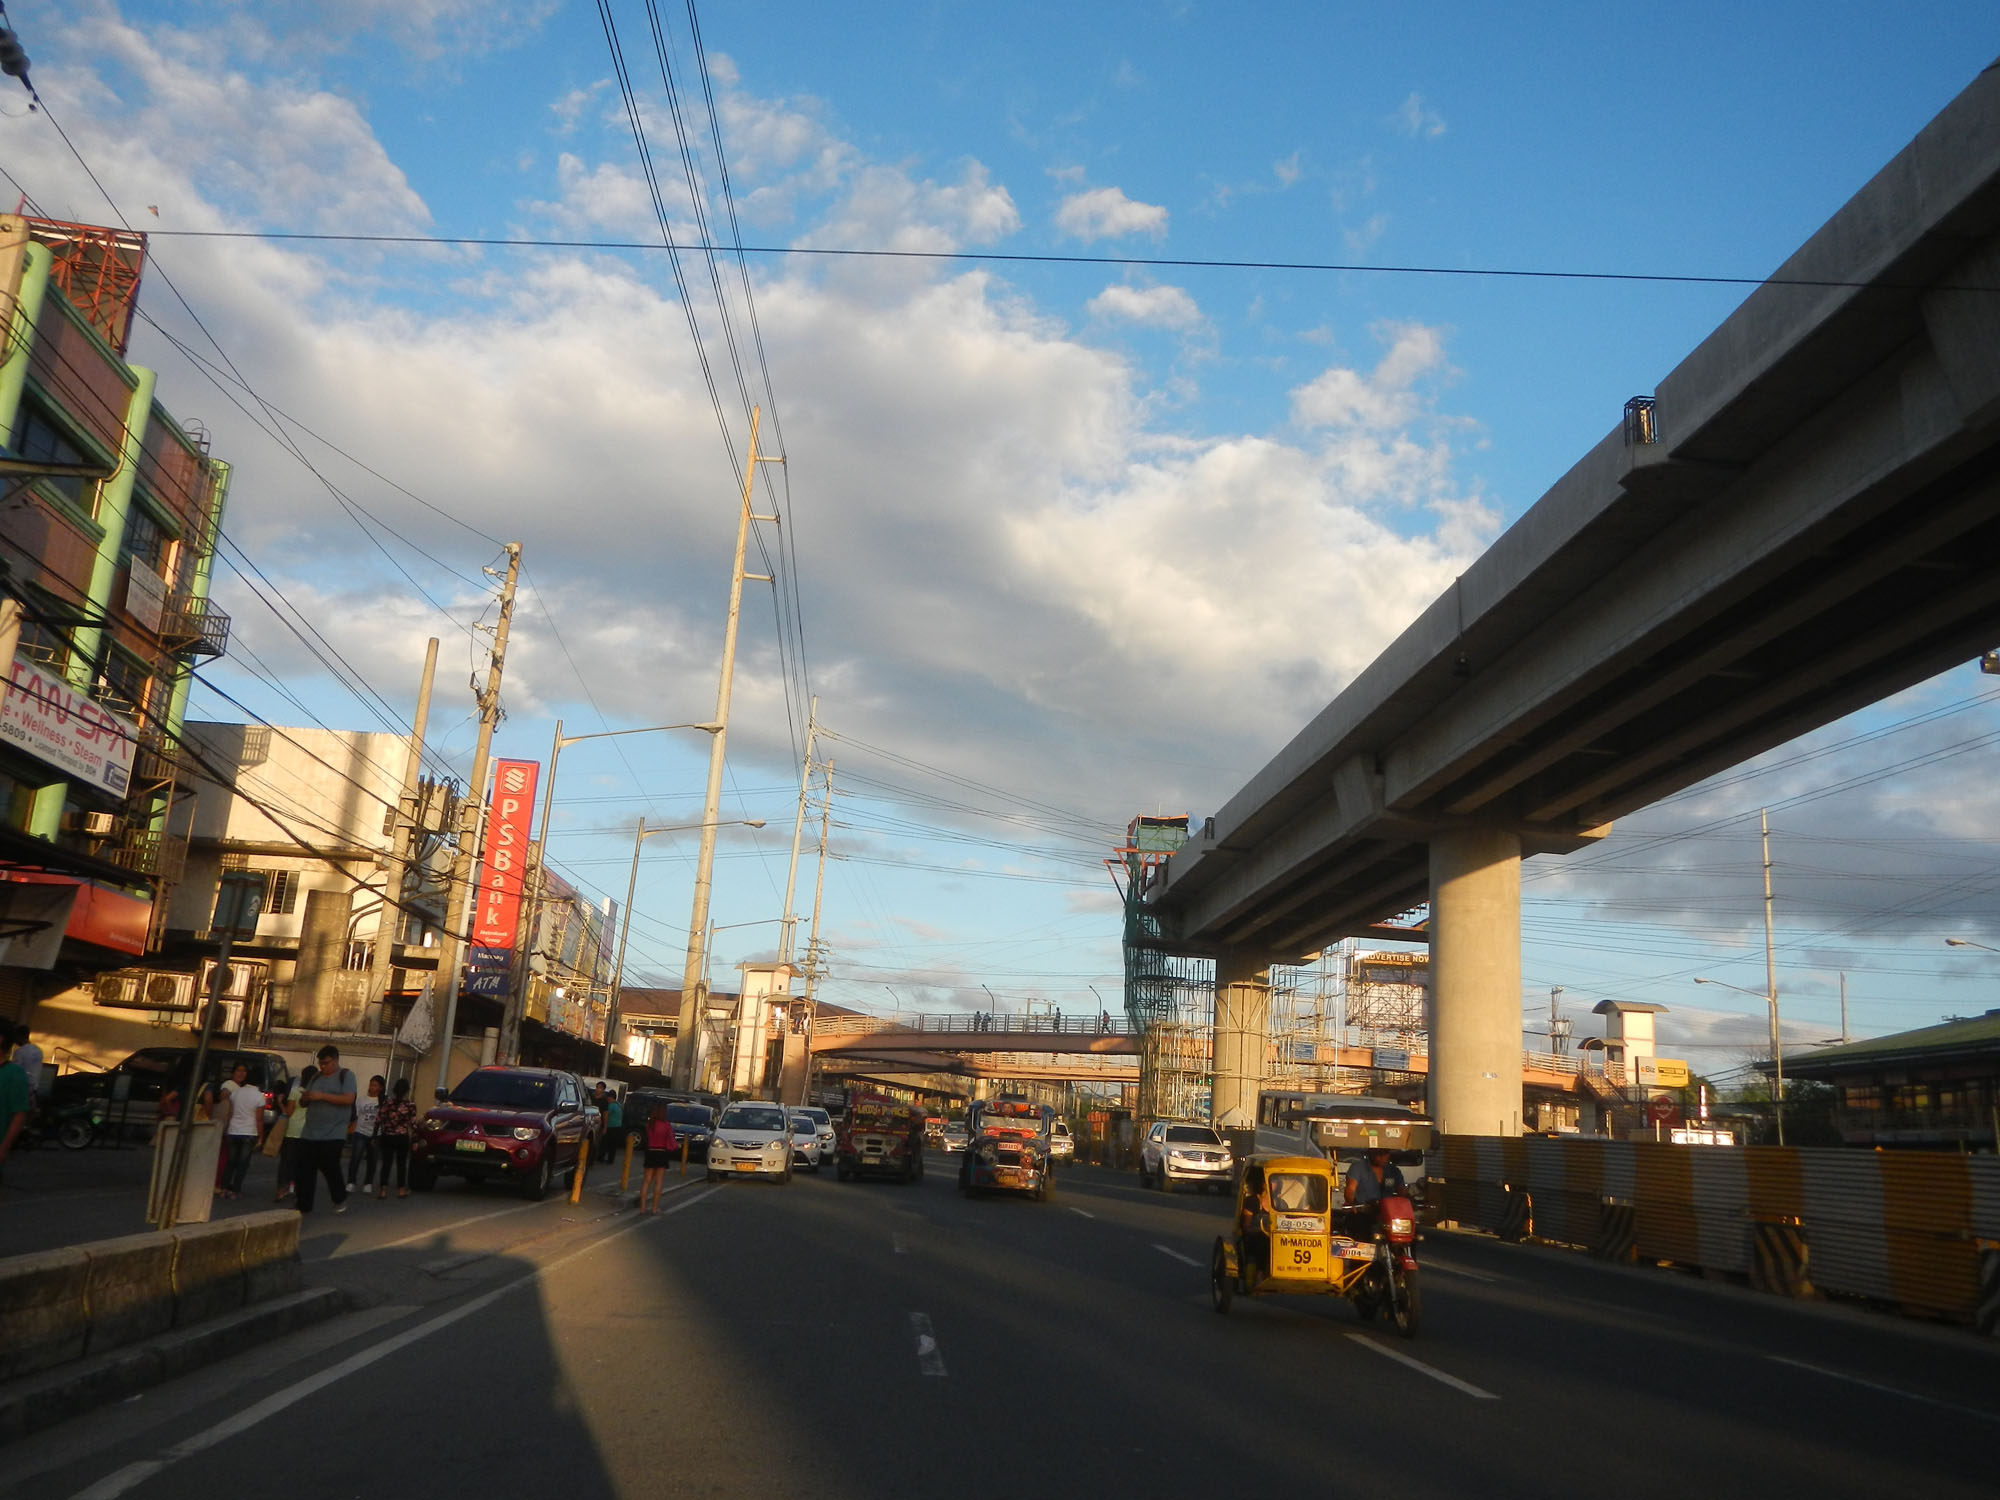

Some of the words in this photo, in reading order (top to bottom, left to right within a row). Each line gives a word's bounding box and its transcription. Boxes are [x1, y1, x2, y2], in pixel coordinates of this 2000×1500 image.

[21, 711, 66, 748] Wellness
[73, 740, 102, 768] Steam
[75, 702, 127, 760] SPA
[486, 798, 519, 926] PSBank
[472, 975, 501, 990] ATM
[1280, 1237, 1323, 1249] M-MATODA
[1293, 1249, 1312, 1265] 59
